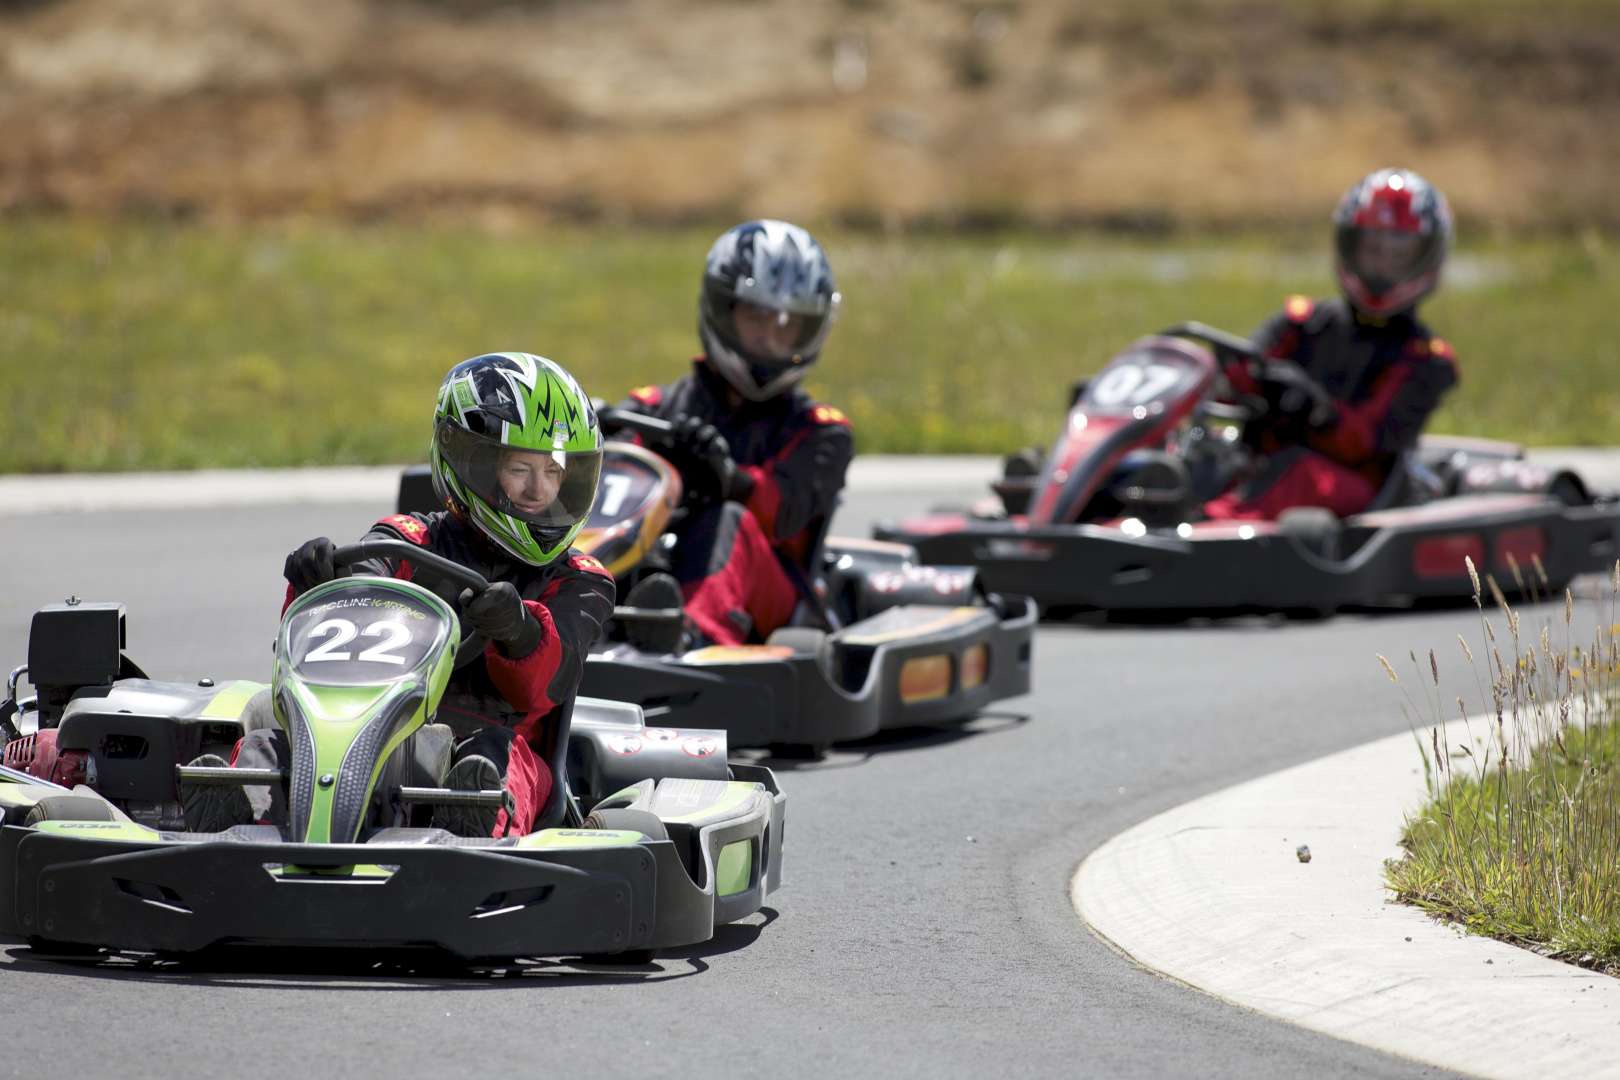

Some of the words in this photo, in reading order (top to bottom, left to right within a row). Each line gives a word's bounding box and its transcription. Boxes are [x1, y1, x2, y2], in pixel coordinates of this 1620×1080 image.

[1094, 364, 1180, 404] 07
[602, 474, 631, 516] 1
[308, 597, 371, 616] RACELINE
[304, 618, 413, 665] 22
